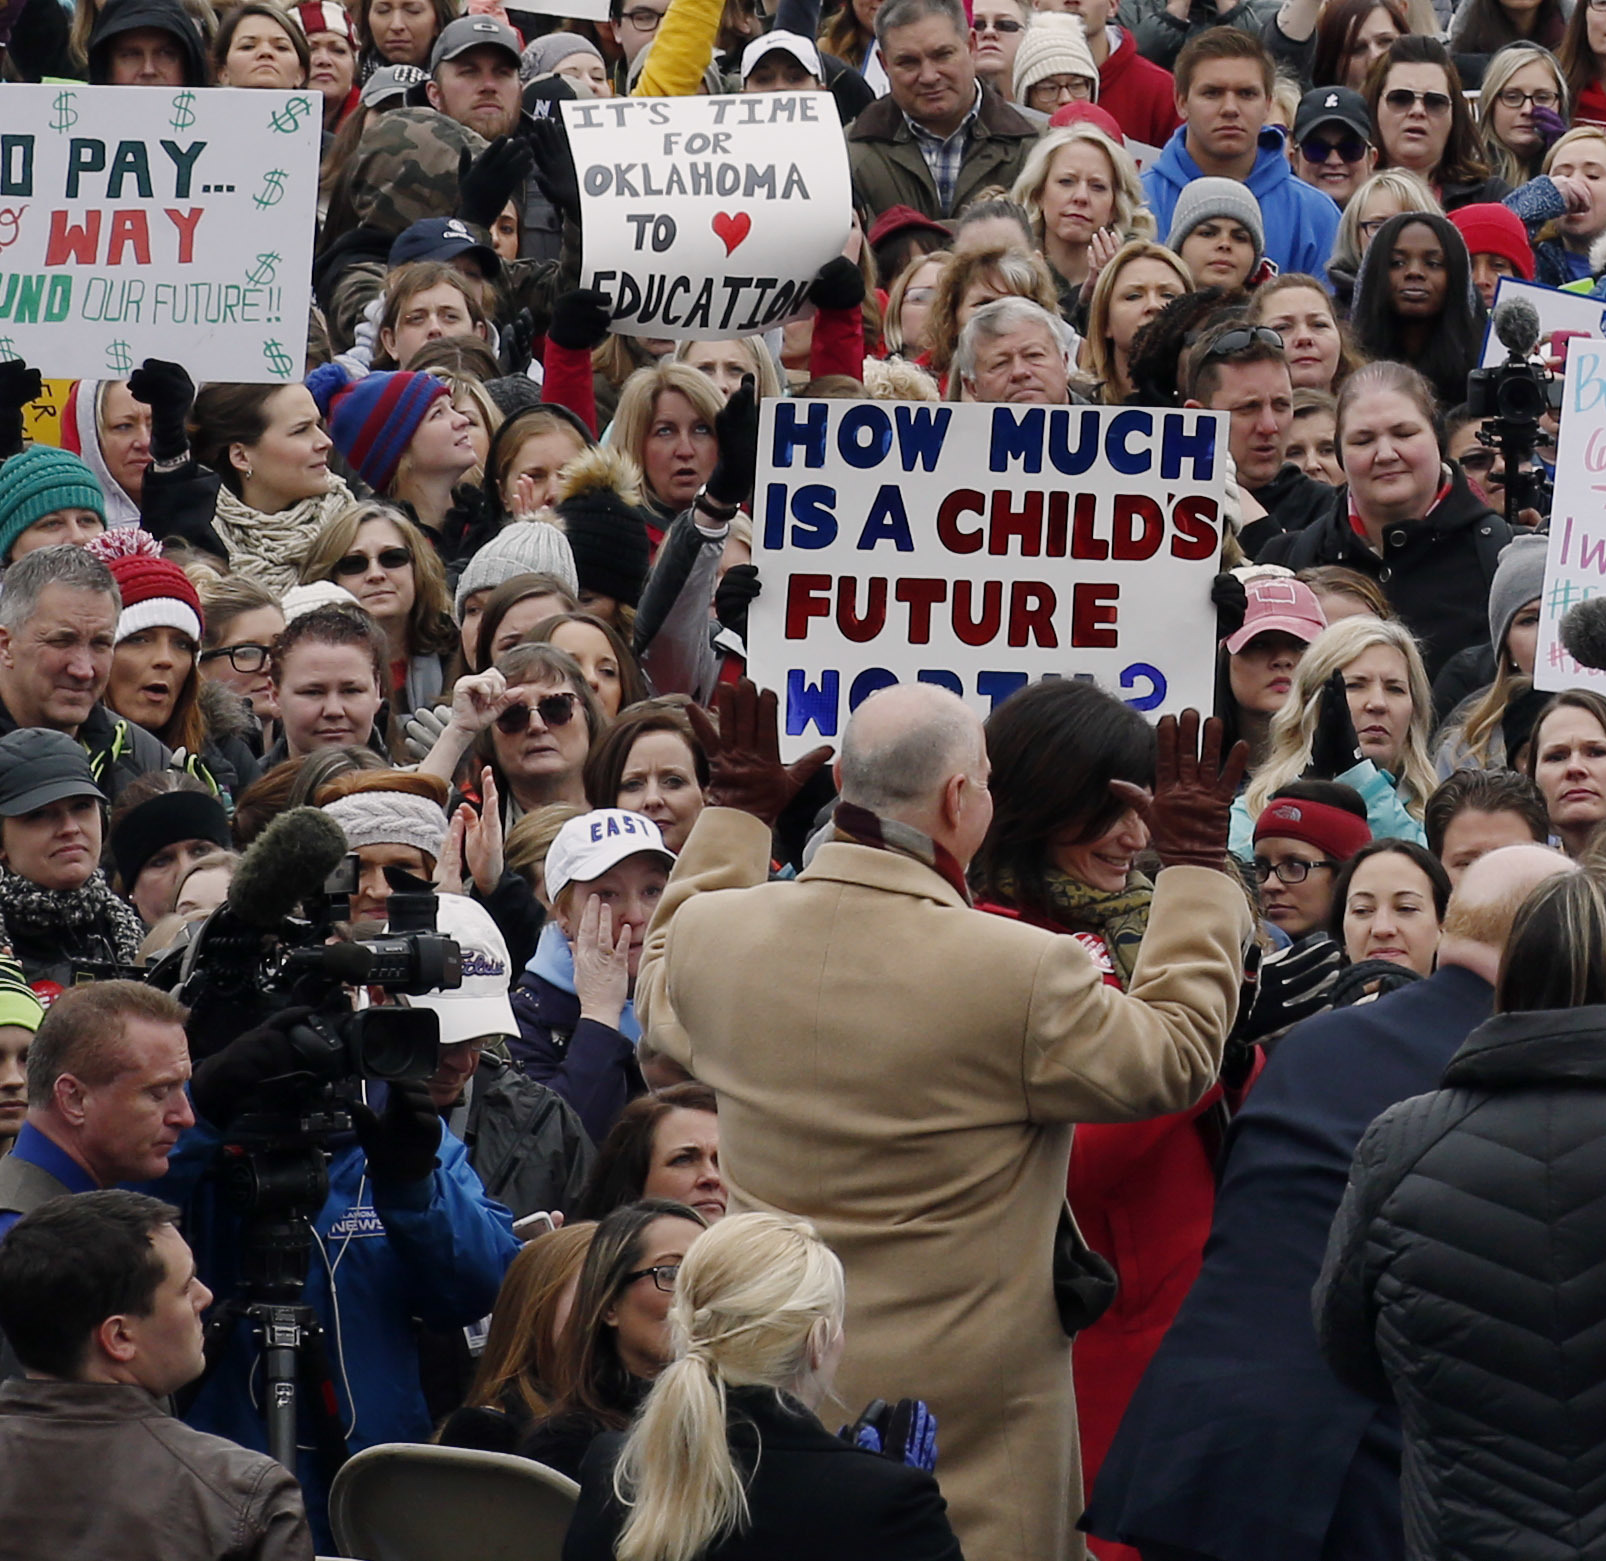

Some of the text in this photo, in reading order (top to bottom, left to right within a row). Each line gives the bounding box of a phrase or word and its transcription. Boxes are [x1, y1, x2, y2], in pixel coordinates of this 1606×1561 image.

[569, 96, 821, 130] IT'S TIME
[662, 130, 732, 156] FOR
[583, 160, 812, 202] OKLAHOMA
[44, 206, 204, 266] WAY
[624, 212, 677, 253] TO
[81, 278, 282, 325] OUR FUTURE!!
[590, 269, 817, 331] EDUCATION
[771, 402, 1217, 482] HOW MUCH
[763, 482, 1219, 562] IS A CHILD'S
[1557, 516, 1575, 567] I
[784, 572, 1120, 649] FUTURE
[590, 816, 652, 842] EAST
